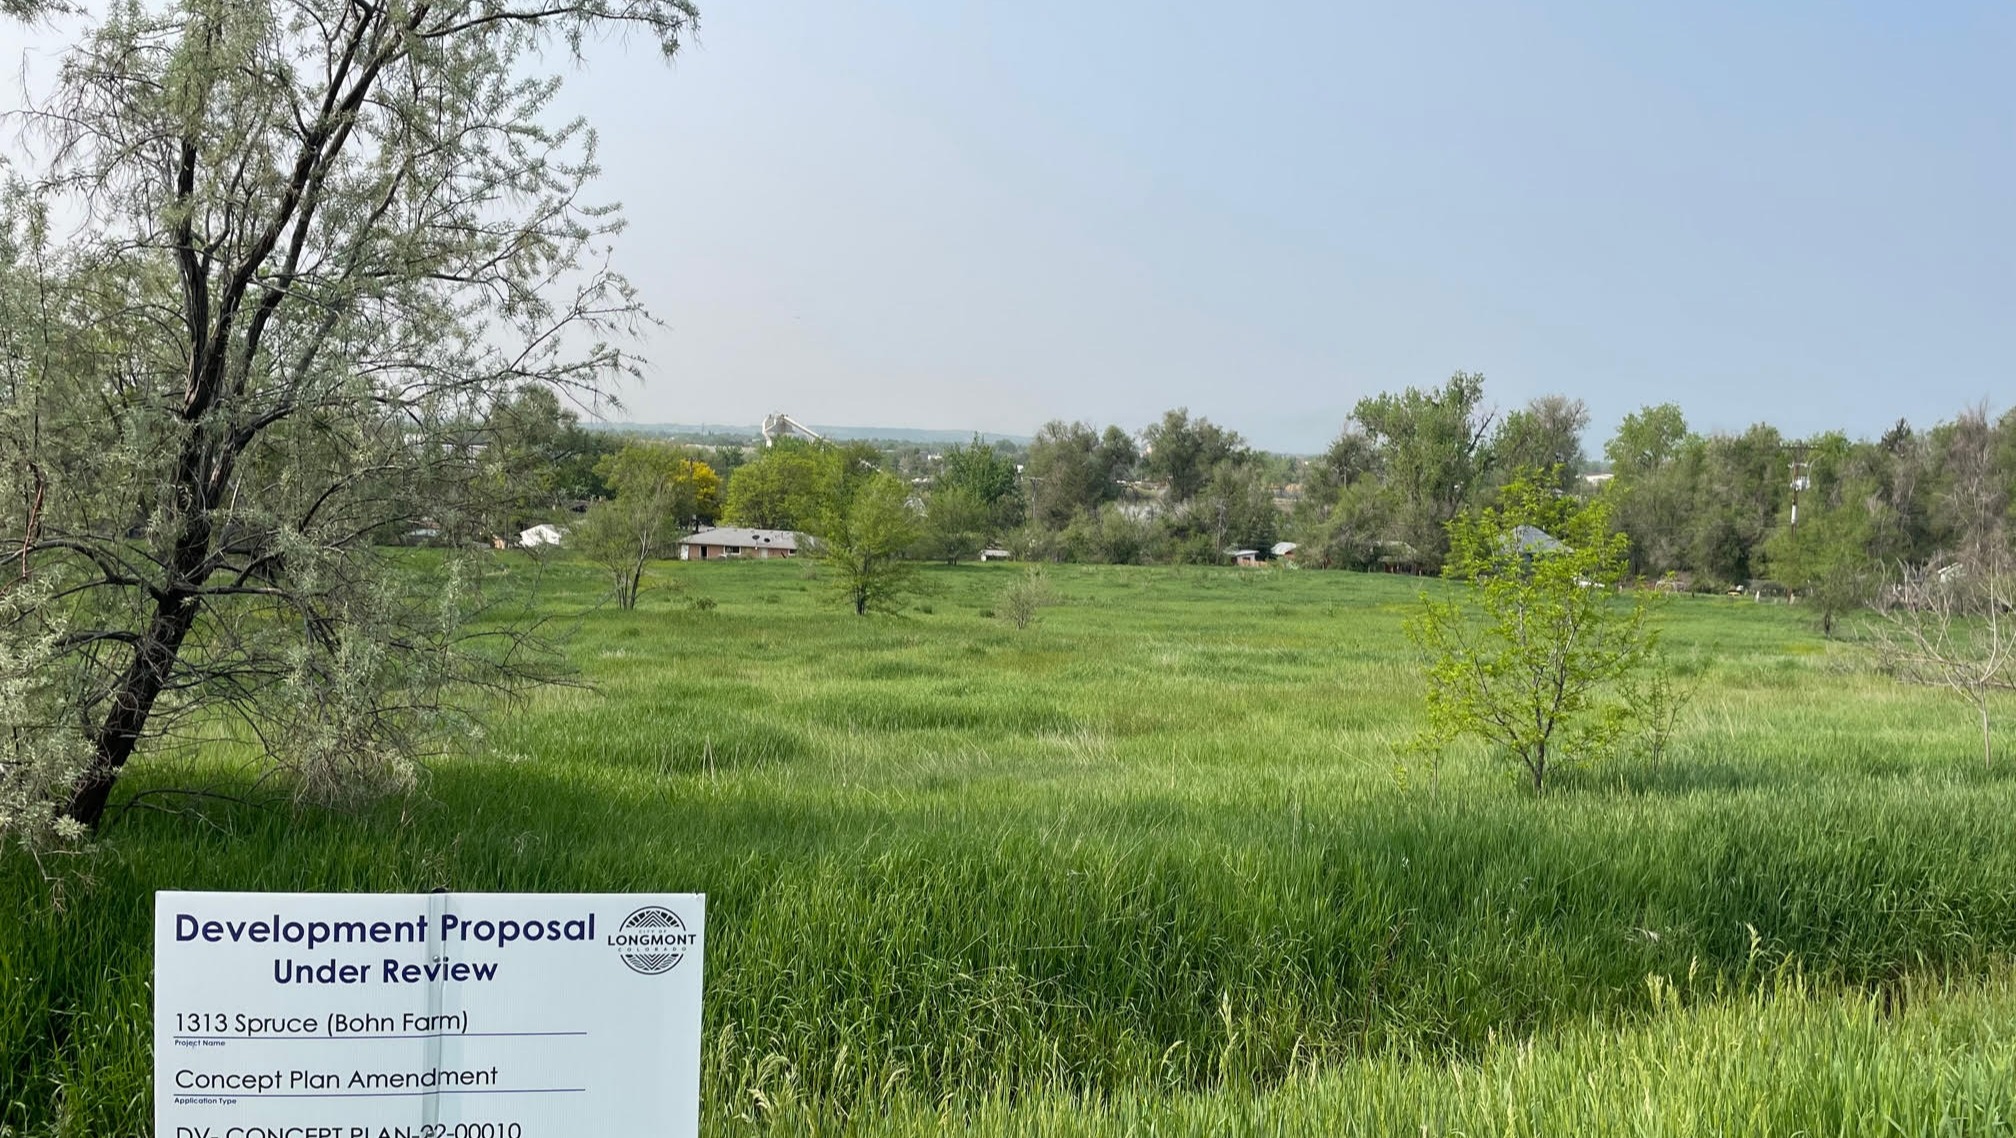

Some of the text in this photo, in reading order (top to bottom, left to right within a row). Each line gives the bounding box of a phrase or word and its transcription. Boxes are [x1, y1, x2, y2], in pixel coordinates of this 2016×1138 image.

[175, 913, 595, 949] Development Proposal
[607, 934, 697, 946] LONGMONT
[274, 957, 498, 984] Under Review
[176, 1010, 468, 1037] 1313 Spruce (Bohn Farm)
[174, 1039, 226, 1047] Project Name
[175, 1067, 498, 1093] Concept Plan Amendment
[174, 1097, 237, 1105] Application Type
[176, 1127, 219, 1138] DV-
[226, 1127, 343, 1138] CONCEPT
